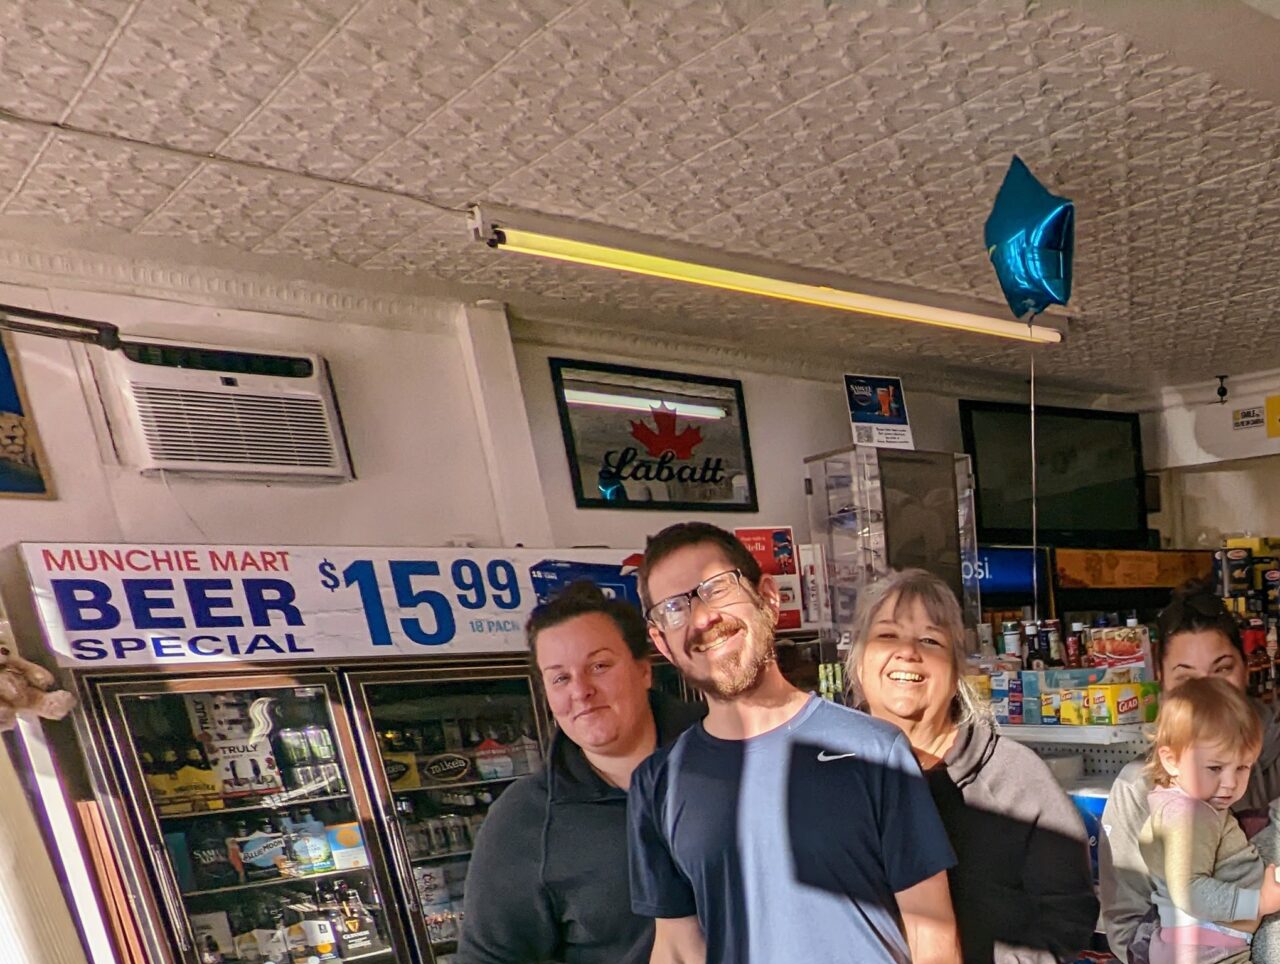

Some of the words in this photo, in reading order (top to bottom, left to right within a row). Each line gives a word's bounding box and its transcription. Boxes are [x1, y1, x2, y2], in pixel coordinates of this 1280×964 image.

[600, 447, 724, 482] Labatt
[42, 549, 200, 571] MUNCHIE
[208, 551, 290, 571] MART
[50, 578, 306, 631] BEER
[70, 633, 315, 660] SPECIAL
[1119, 699, 1138, 712] GLAD
[220, 743, 258, 755] TRULY
[263, 839, 284, 852] MOON
